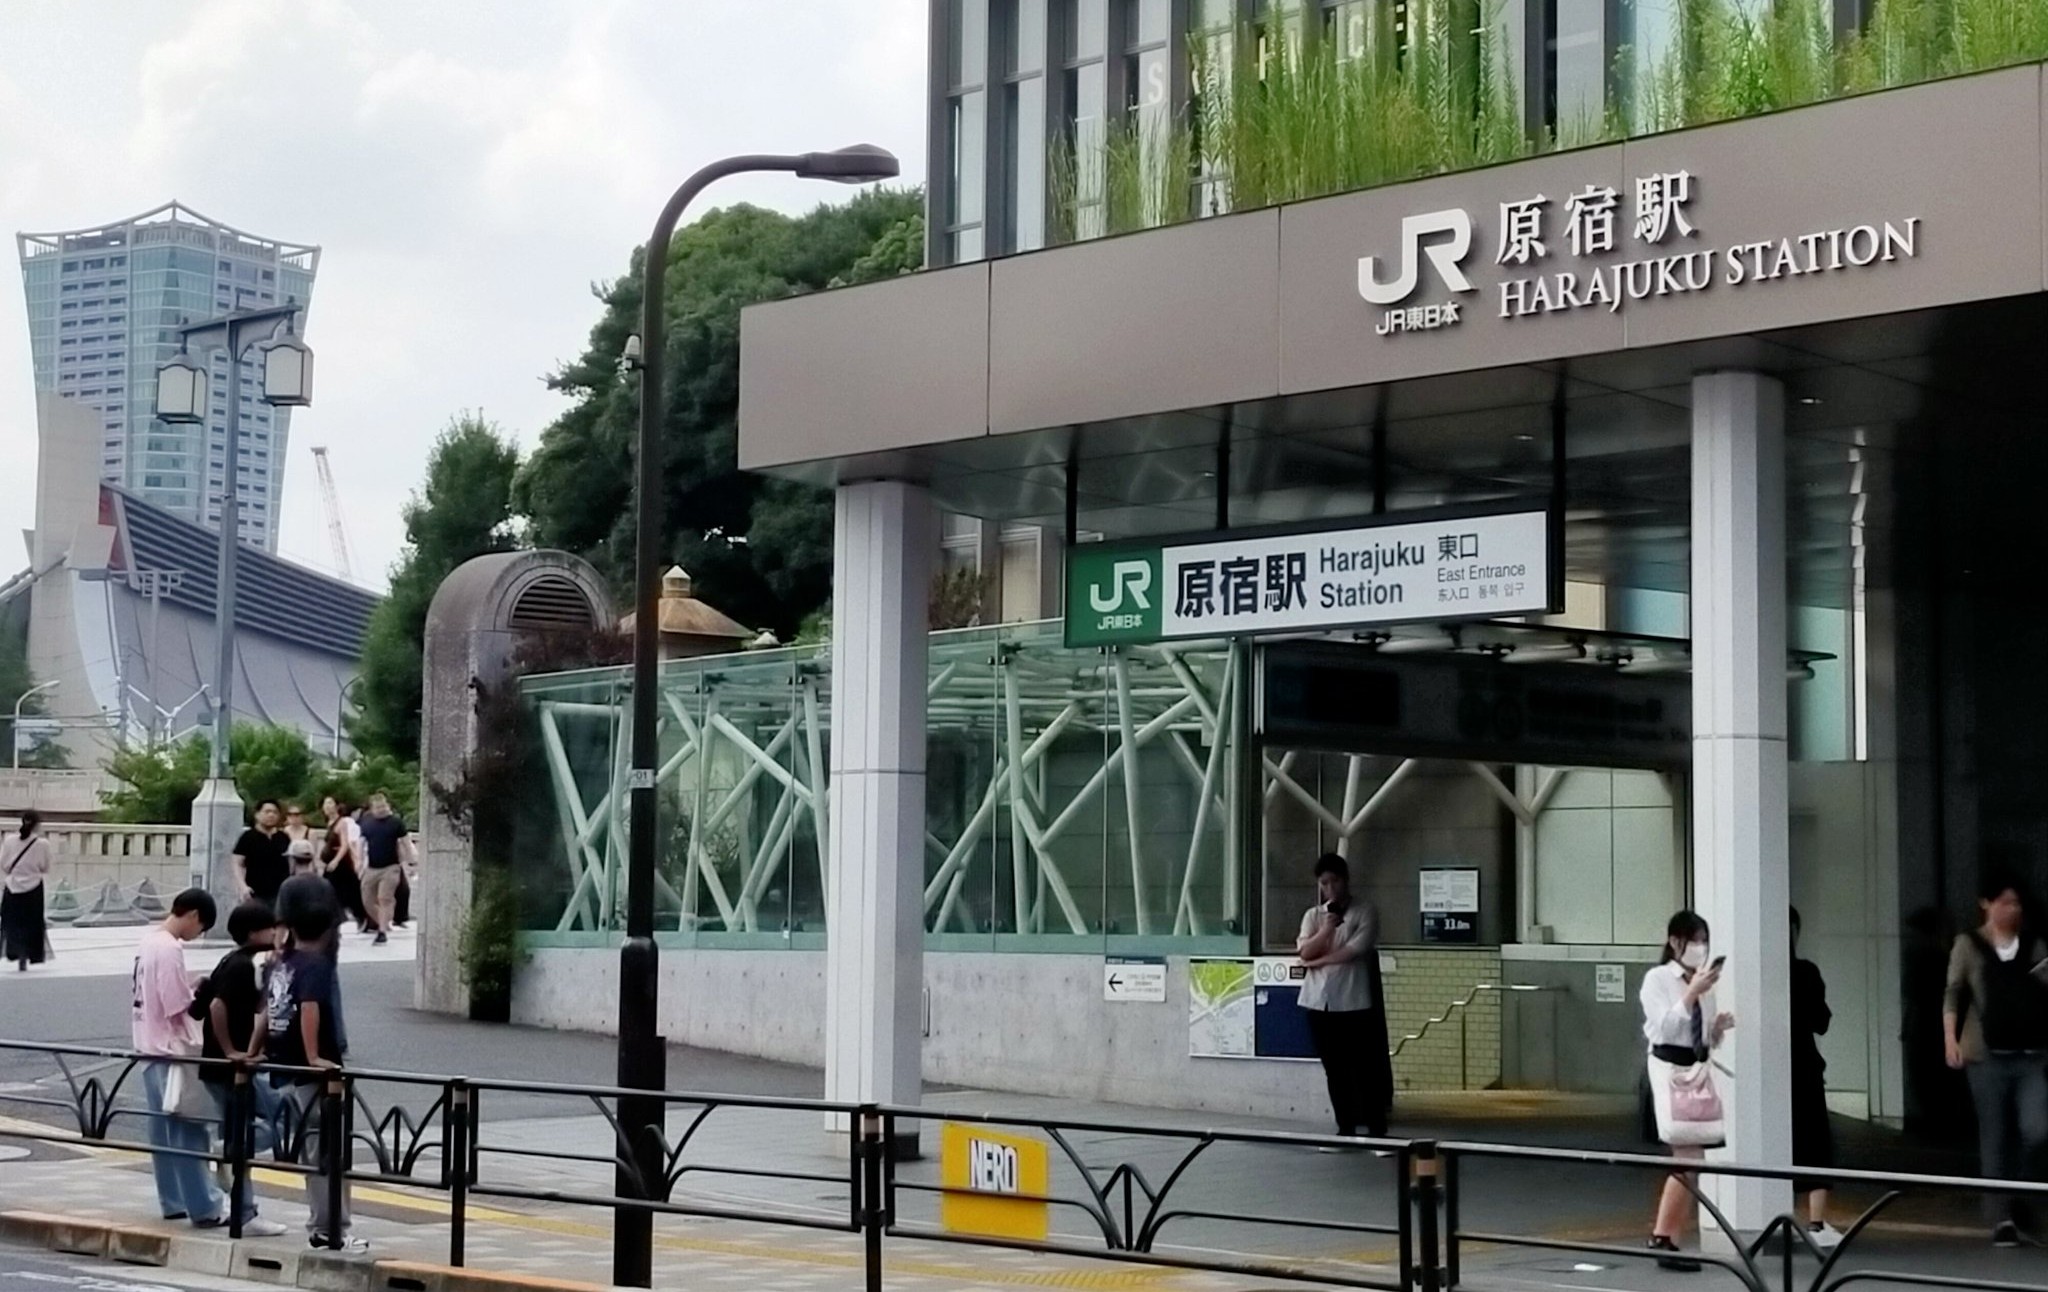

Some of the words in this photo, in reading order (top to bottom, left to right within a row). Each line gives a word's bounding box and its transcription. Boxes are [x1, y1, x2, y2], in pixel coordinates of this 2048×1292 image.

[1495, 169, 1694, 265] 原宿駅
[1358, 208, 1471, 304] JR
[1498, 249, 1715, 318] HARAJUKU
[1726, 217, 1920, 285] STATION
[1376, 301, 1459, 334] JR東日本
[1320, 541, 1425, 575] Harajuku
[1438, 533, 1478, 561] 東口
[1438, 567, 1464, 582] East
[1470, 564, 1525, 580] Entrance
[1090, 560, 1151, 612] JR
[1174, 552, 1307, 618] 原宿駅
[1320, 580, 1403, 608] Station
[969, 1138, 1019, 1194] NERO
